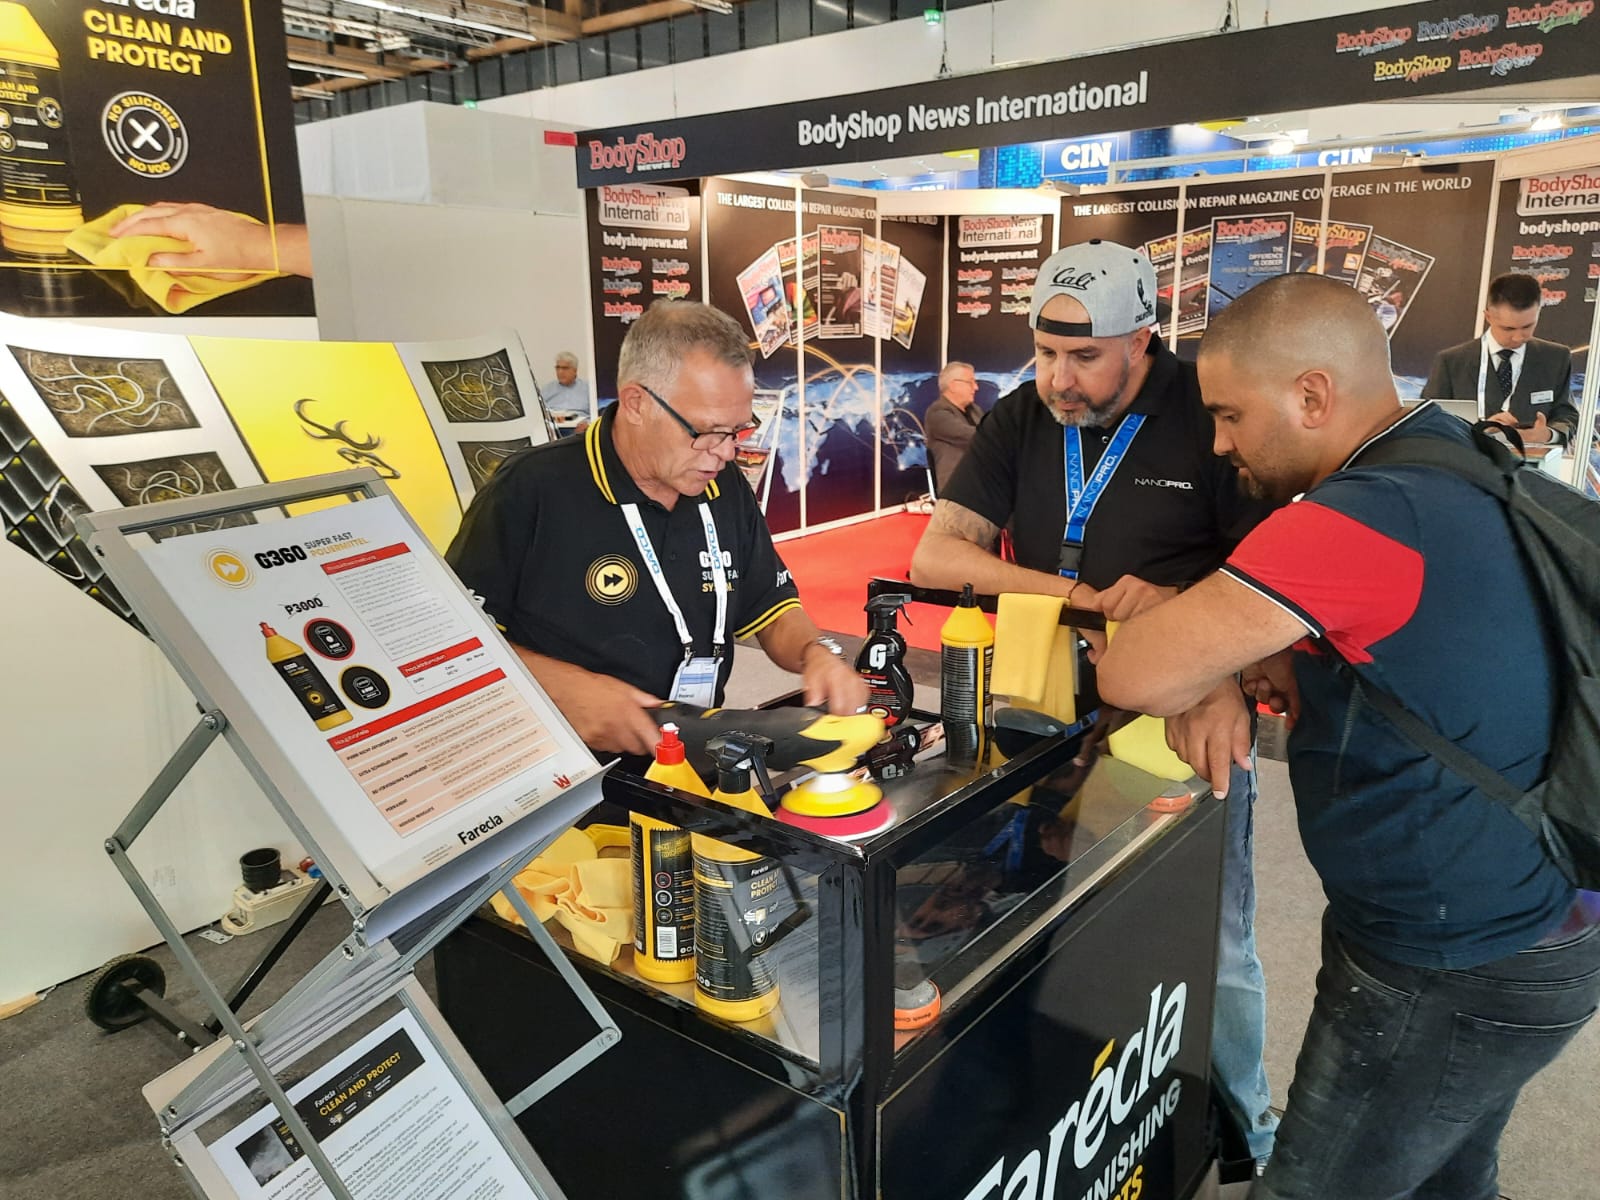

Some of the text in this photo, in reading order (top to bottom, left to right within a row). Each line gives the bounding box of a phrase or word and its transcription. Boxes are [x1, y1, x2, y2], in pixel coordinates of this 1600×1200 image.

[83, 9, 233, 55] CLEAN AND
[1336, 26, 1412, 49] BodyShop
[88, 37, 204, 76] PROTECT
[1374, 54, 1452, 79] BodyShop
[1459, 42, 1544, 67] BodyShop
[107, 95, 180, 130] NO SILICONES
[798, 70, 1149, 149] BodyShop News International
[588, 132, 687, 174] BodyShop
[1060, 142, 1112, 170] CIN
[717, 193, 733, 205] THE
[733, 194, 766, 209] LARGEST
[766, 198, 808, 213] COLLISN
[1073, 205, 1092, 217] THE
[1093, 202, 1136, 216] LARGEST
[1199, 194, 1237, 208] REPAIR
[1239, 189, 1300, 205] MAGAZINE
[1376, 182, 1391, 194] IN
[1394, 179, 1418, 193] THE
[1421, 176, 1473, 191] WORLD
[604, 203, 686, 223] Internatinal
[603, 231, 689, 250] bodyshopnews.net
[962, 227, 1037, 243] Internatinal
[1051, 267, 1096, 290] Cali
[254, 531, 353, 569] G360 SUPER FAST
[635, 527, 661, 575] DAYCO
[706, 522, 721, 570] DAYCO
[284, 597, 324, 615] P3000
[457, 814, 504, 845] Farecla
[319, 1092, 348, 1117] CLEAN
[347, 1078, 367, 1097] AND
[366, 1051, 402, 1082] PROTECT
